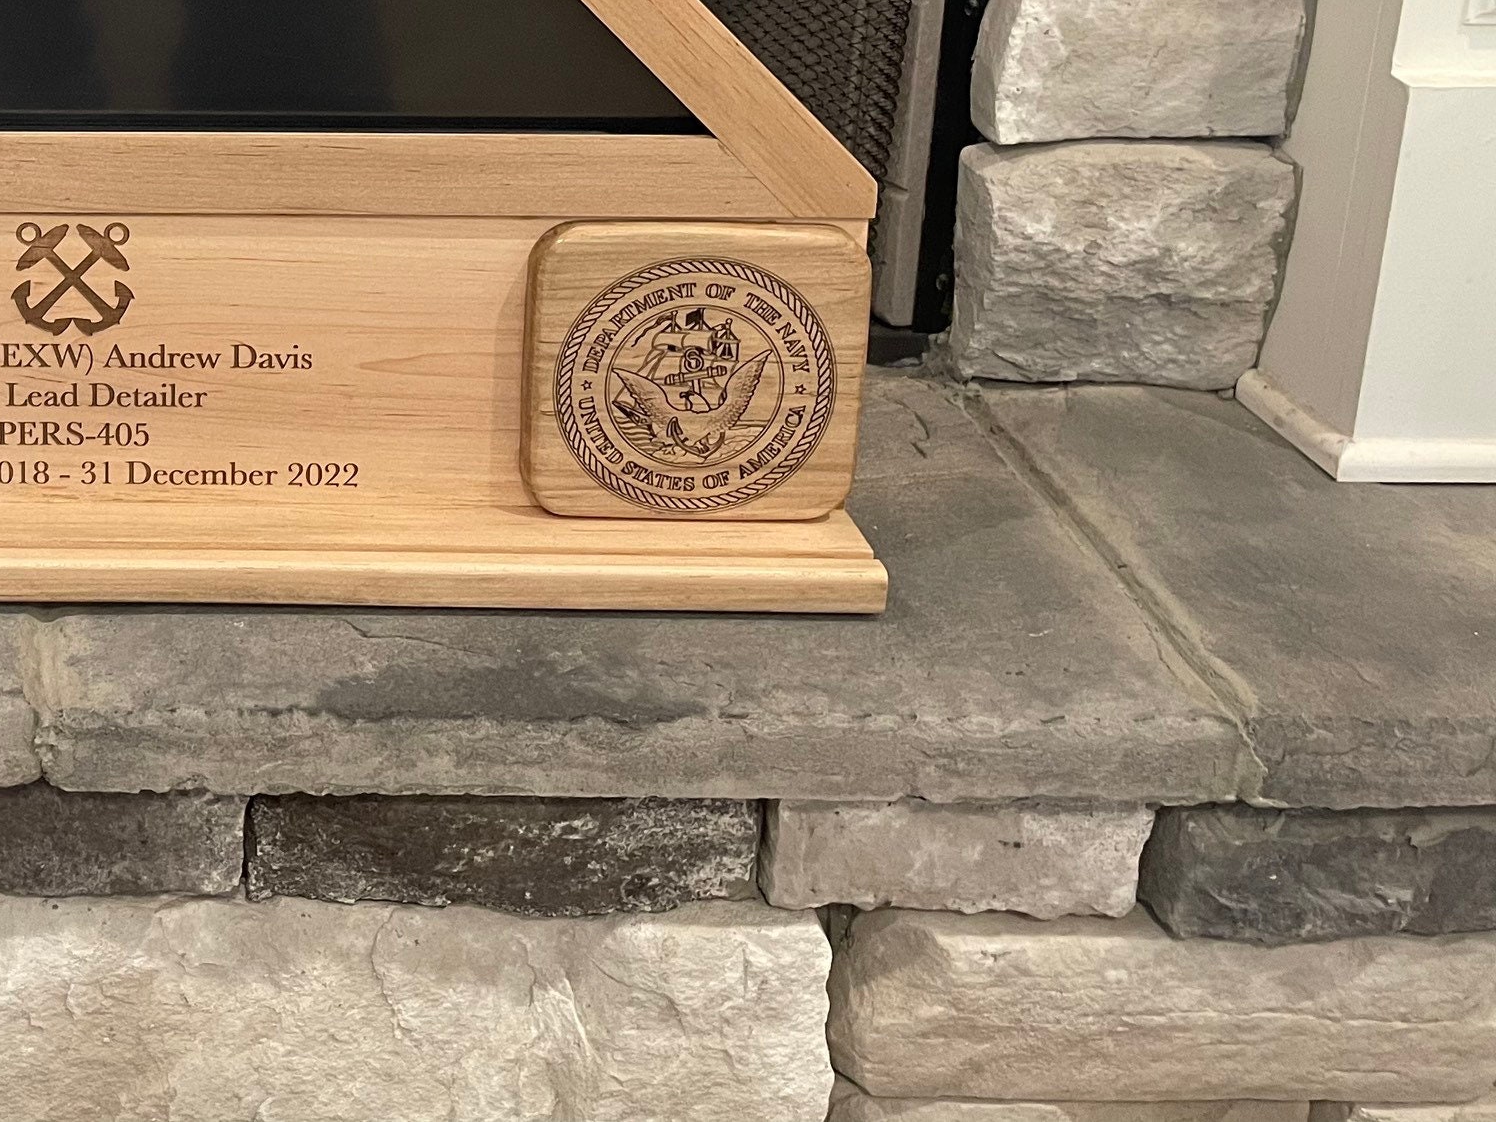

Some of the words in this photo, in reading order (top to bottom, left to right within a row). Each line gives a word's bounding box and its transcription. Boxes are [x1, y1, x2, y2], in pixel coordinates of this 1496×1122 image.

[583, 282, 697, 374] DEPARTMENT
[705, 283, 736, 300] OF
[744, 293, 782, 327] THE
[776, 321, 811, 373] NAVY
[102, 344, 221, 370] Andrew
[230, 344, 313, 371] Davis
[5, 382, 80, 408] Lead
[89, 382, 207, 408] Detailer
[578, 397, 624, 465] UNITED
[621, 460, 696, 492] STATES
[702, 472, 730, 490] OF
[739, 404, 807, 480] AMERICA
[81, 462, 113, 485] 31
[126, 462, 278, 487] December
[287, 463, 359, 488] 2022
